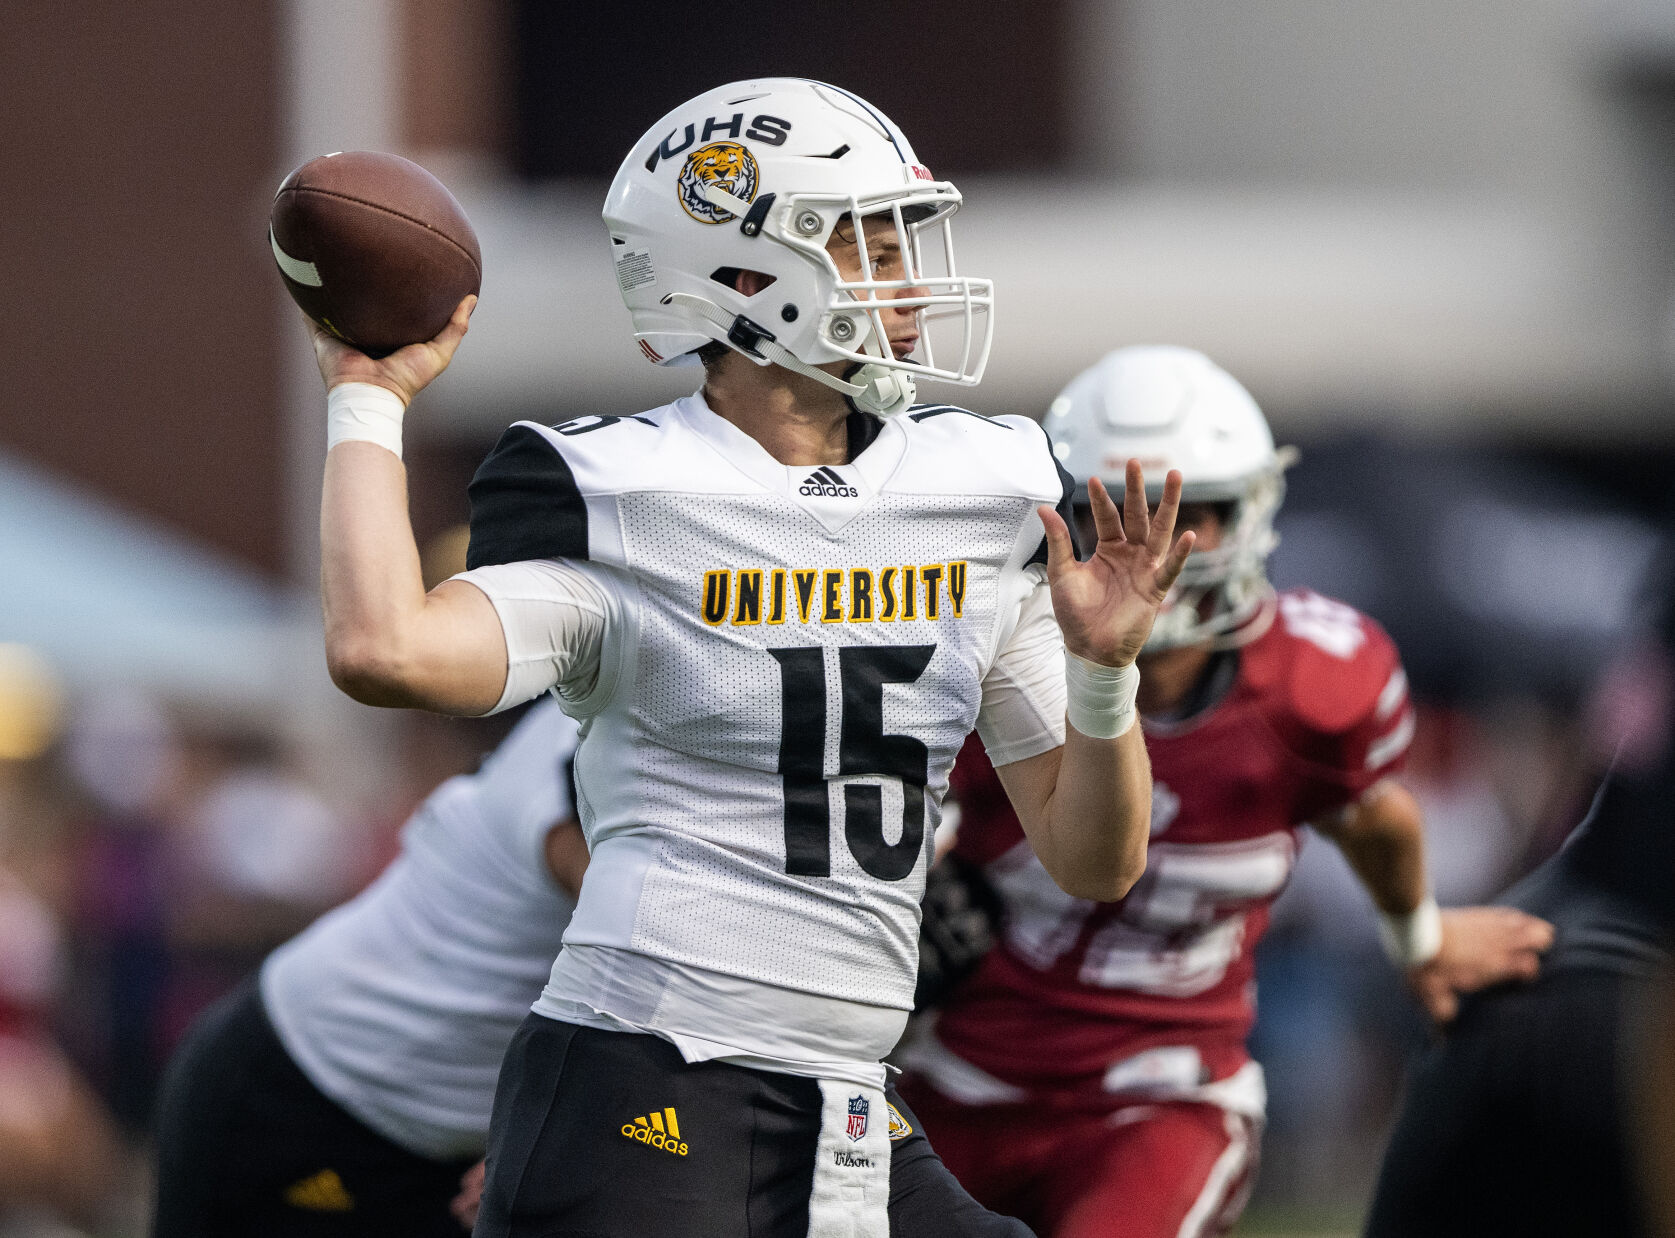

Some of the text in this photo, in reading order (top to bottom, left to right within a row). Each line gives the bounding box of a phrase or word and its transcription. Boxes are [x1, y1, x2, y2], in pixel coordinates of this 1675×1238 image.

[660, 113, 792, 160] UHS
[799, 484, 858, 498] adidas
[702, 561, 967, 626] UNIVERSITY
[766, 643, 937, 882] 15
[621, 1124, 689, 1156] adidas
[846, 1114, 865, 1138] NFL
